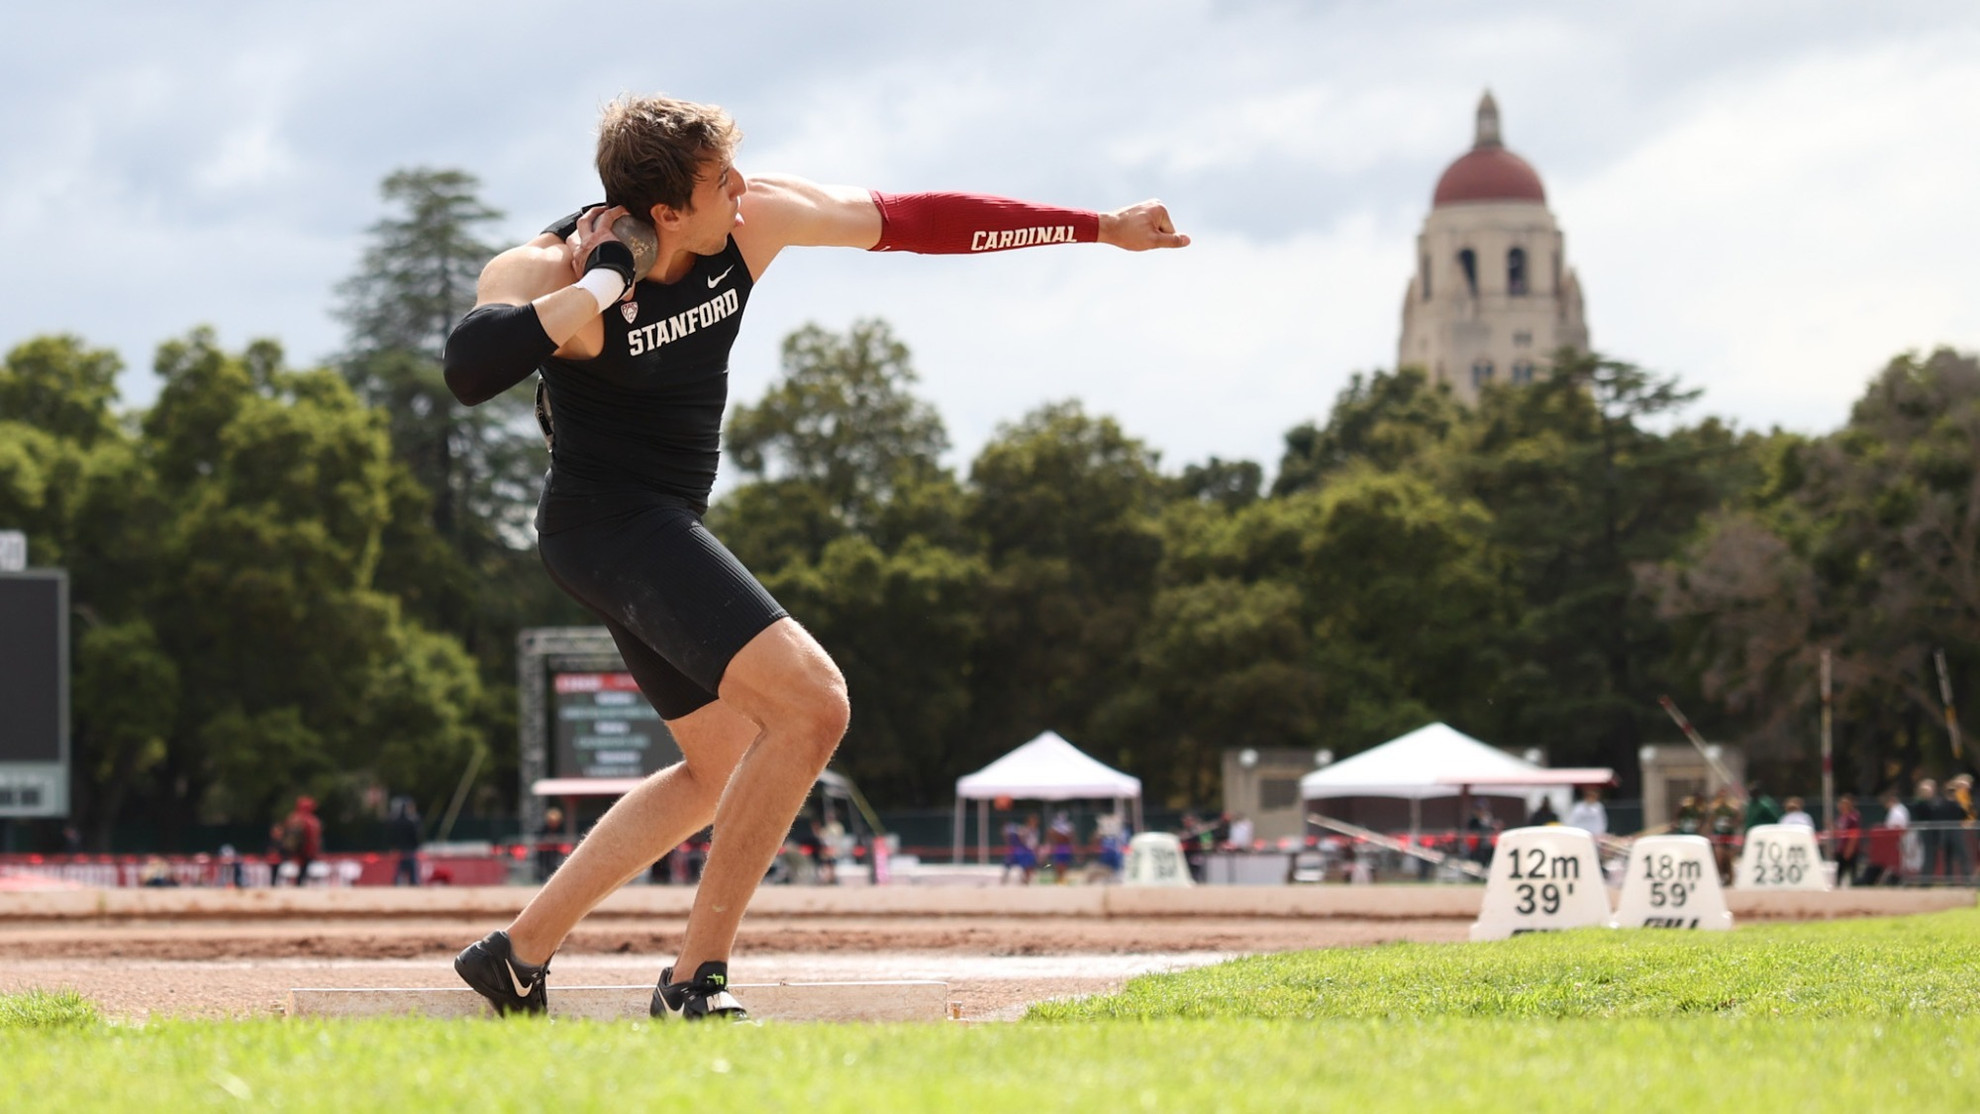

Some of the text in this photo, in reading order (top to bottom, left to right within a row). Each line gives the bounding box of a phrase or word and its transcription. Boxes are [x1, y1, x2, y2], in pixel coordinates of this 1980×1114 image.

[971, 225, 1077, 251] CARDINAL
[627, 287, 739, 357] STANFORD
[1508, 848, 1579, 879] 12m
[1754, 841, 1806, 861] 70m
[1643, 855, 1701, 879] 18m
[1516, 883, 1574, 915] 39'
[1650, 882, 1695, 907] 59'
